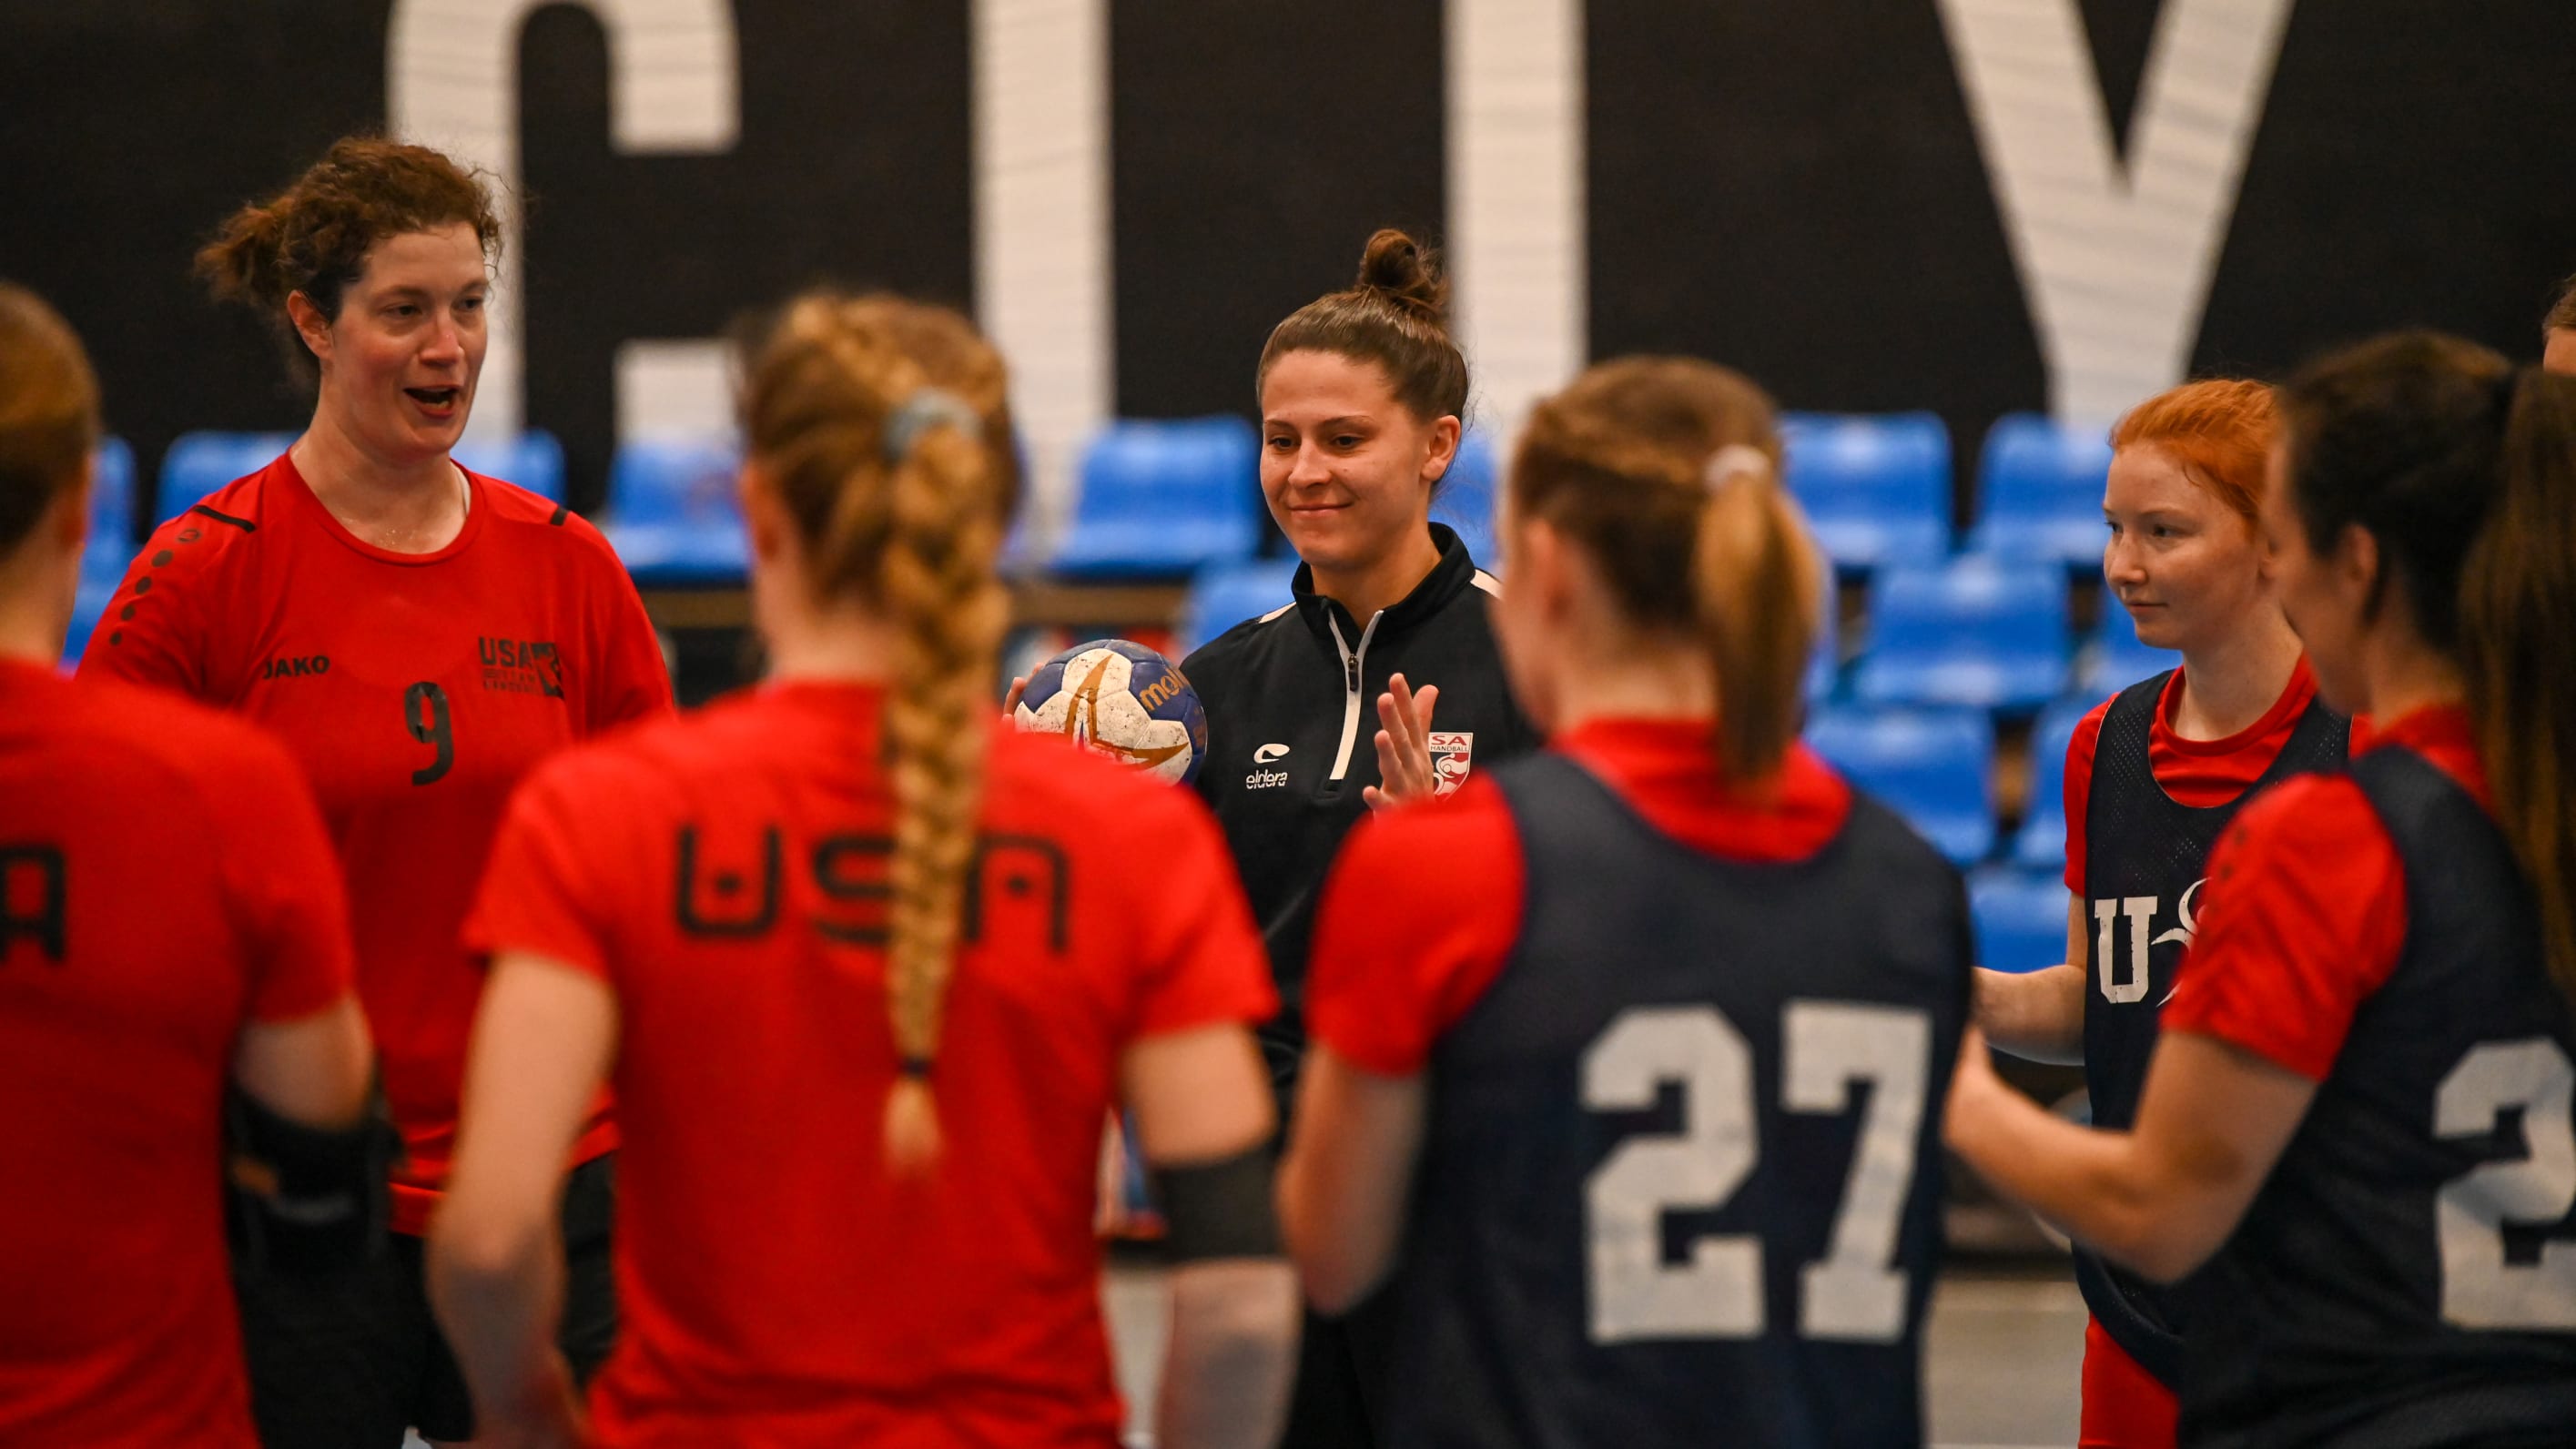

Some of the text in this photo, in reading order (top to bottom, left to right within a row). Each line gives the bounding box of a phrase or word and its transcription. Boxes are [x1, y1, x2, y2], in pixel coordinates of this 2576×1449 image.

[262, 654, 330, 680] JAKO
[479, 636, 533, 670] USA
[404, 681, 454, 786] 9
[1431, 735, 1467, 745] SA
[1246, 769, 1288, 790] eldera
[675, 822, 1069, 956] USA
[1580, 998, 1930, 1345] 27
[2432, 1036, 2576, 1331] 2
